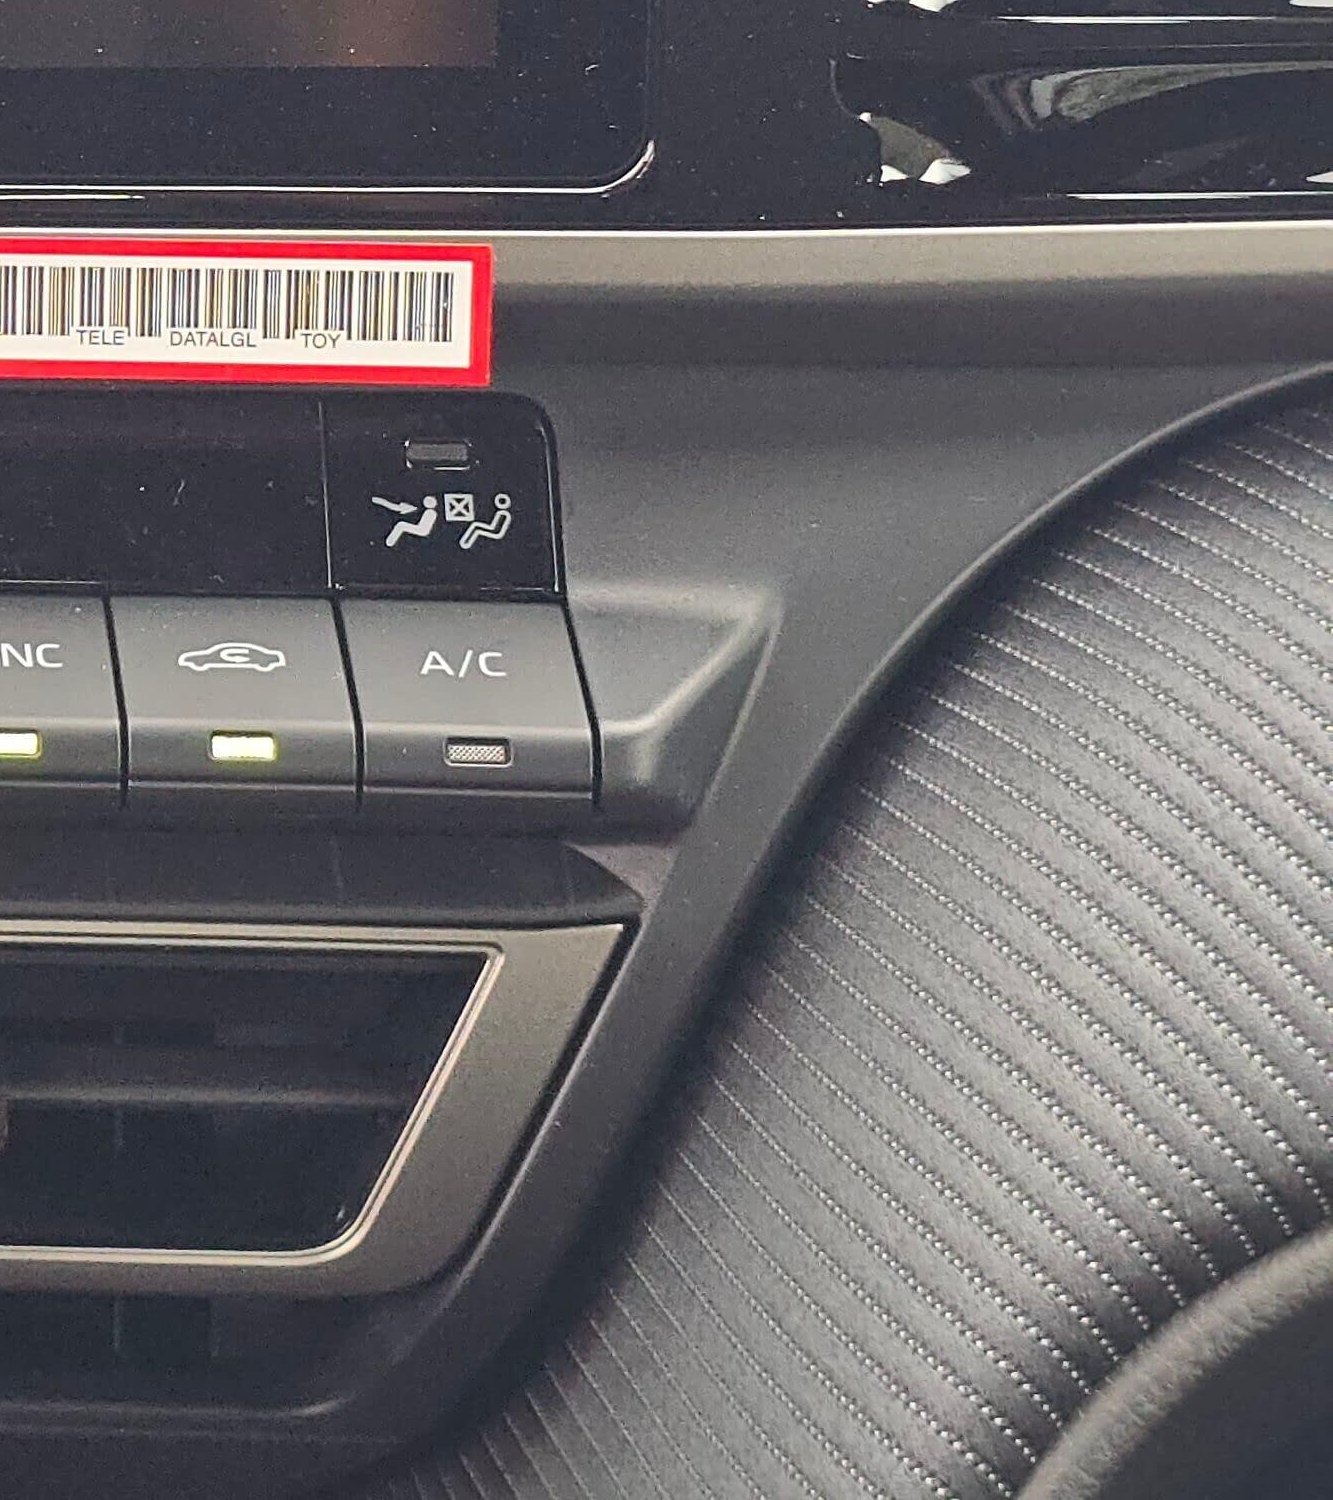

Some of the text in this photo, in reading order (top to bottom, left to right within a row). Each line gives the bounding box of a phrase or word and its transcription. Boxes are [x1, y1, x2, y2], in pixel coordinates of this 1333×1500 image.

[75, 329, 341, 350] TELE DATALGL TOY
[420, 649, 508, 679] A/C
